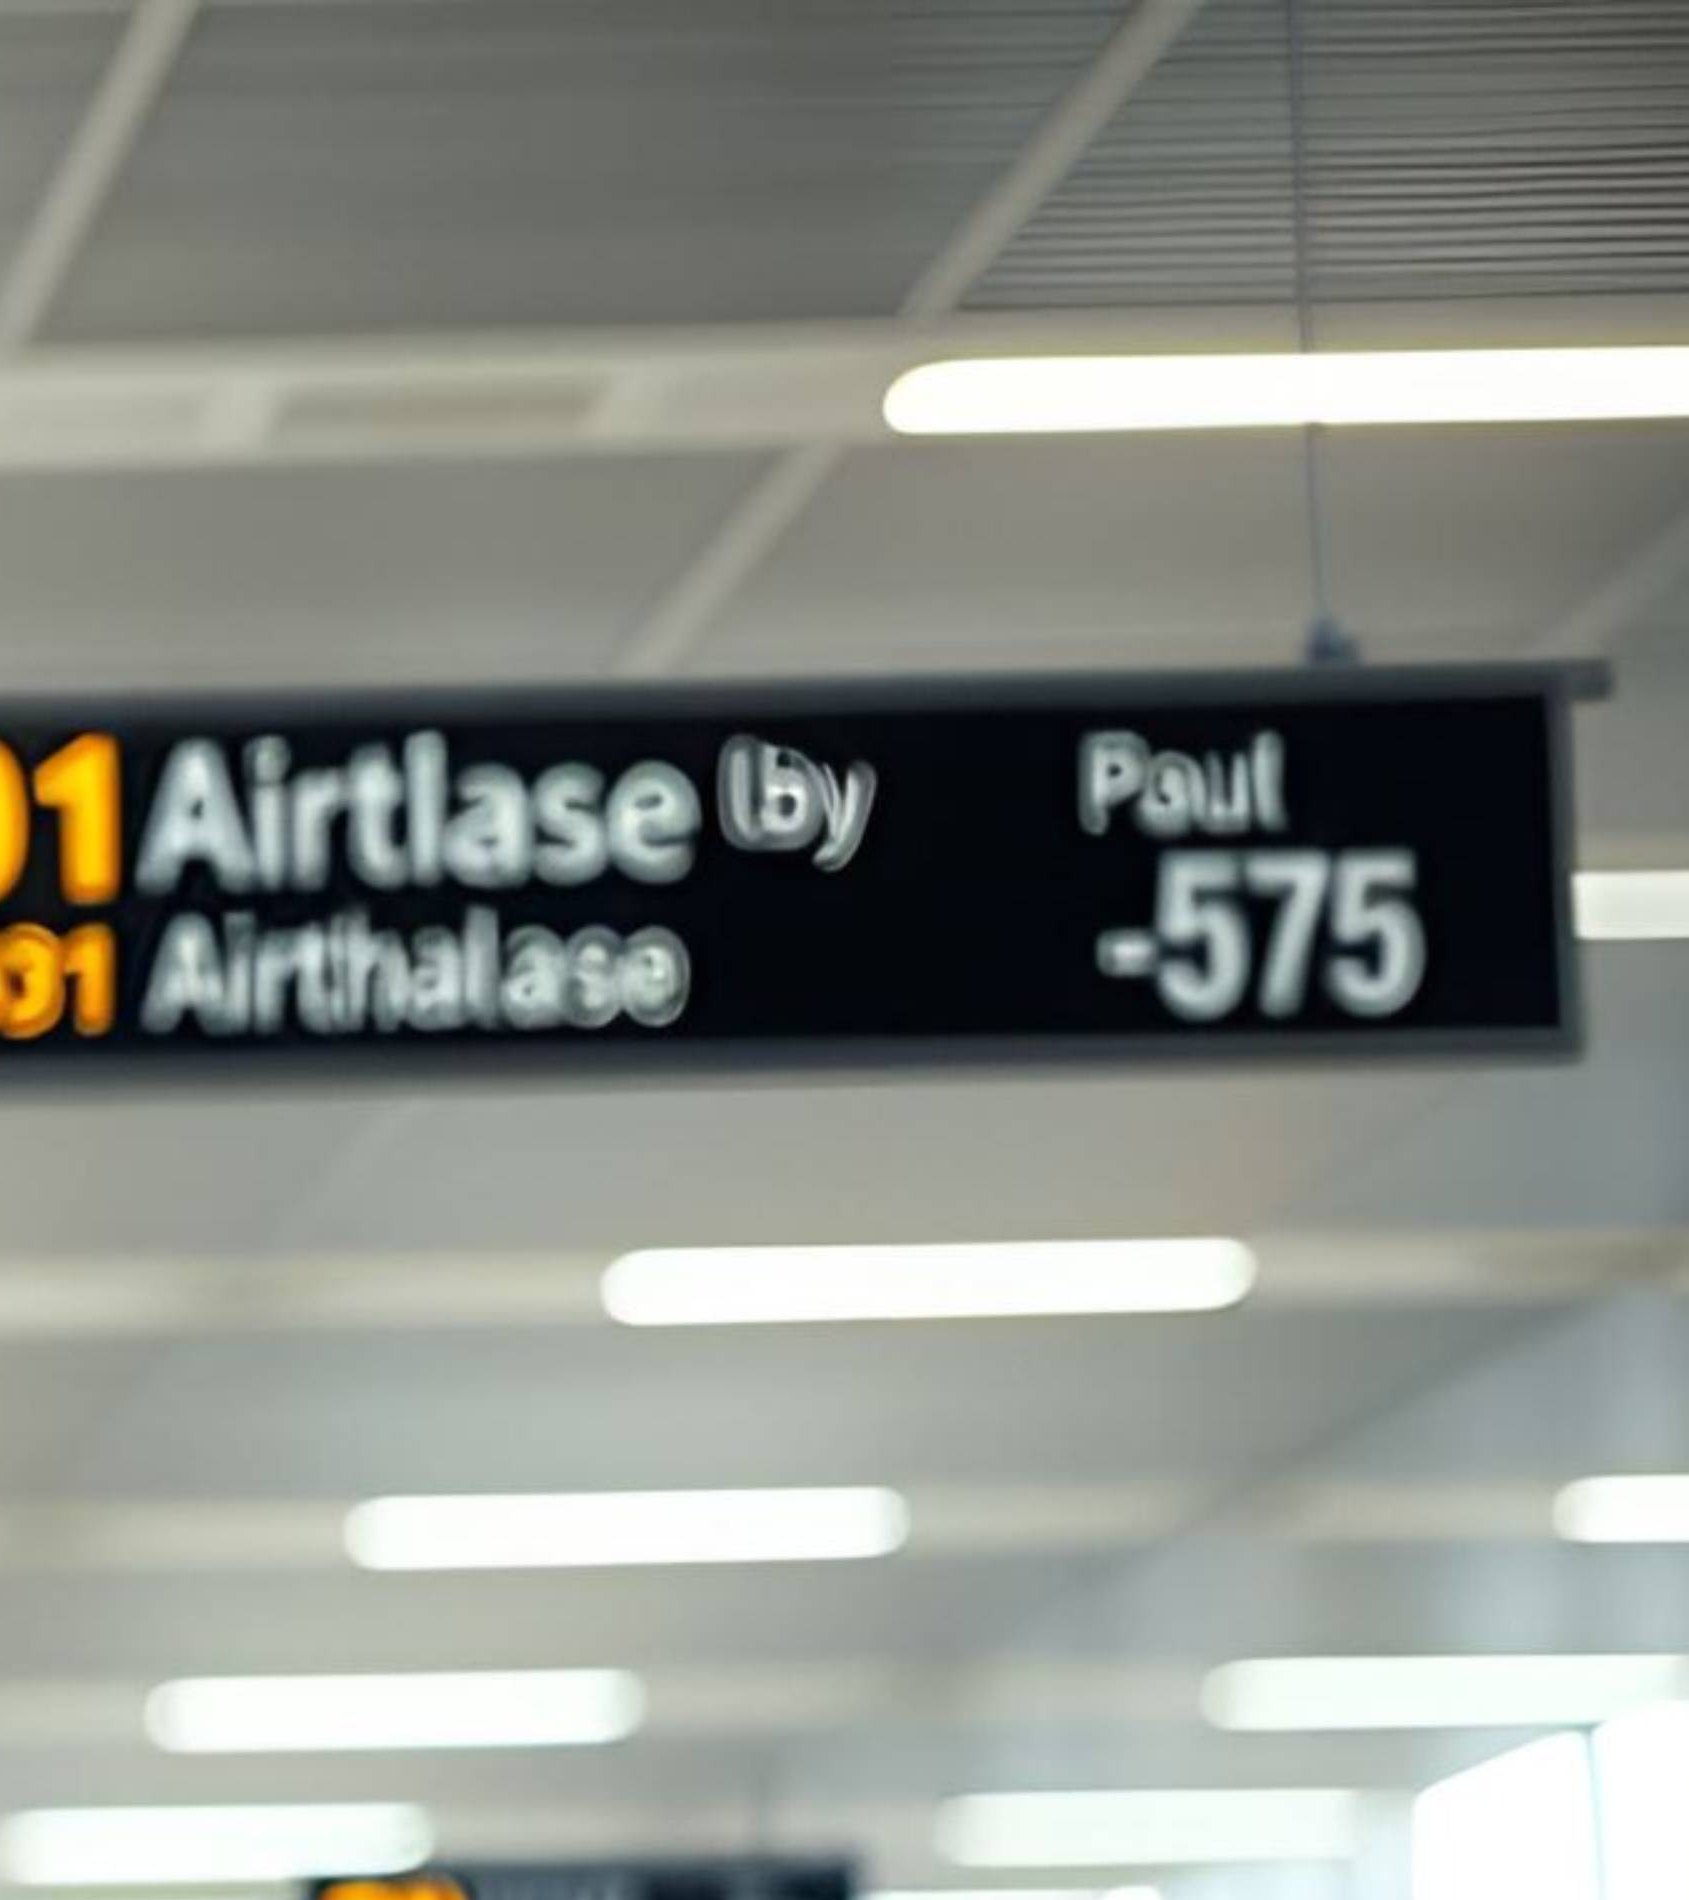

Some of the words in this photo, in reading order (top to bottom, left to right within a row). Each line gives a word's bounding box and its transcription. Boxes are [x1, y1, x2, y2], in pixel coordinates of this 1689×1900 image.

[137, 731, 700, 889] Airtlase
[1080, 731, 1285, 835] Paul
[1097, 848, 1425, 1020] -575
